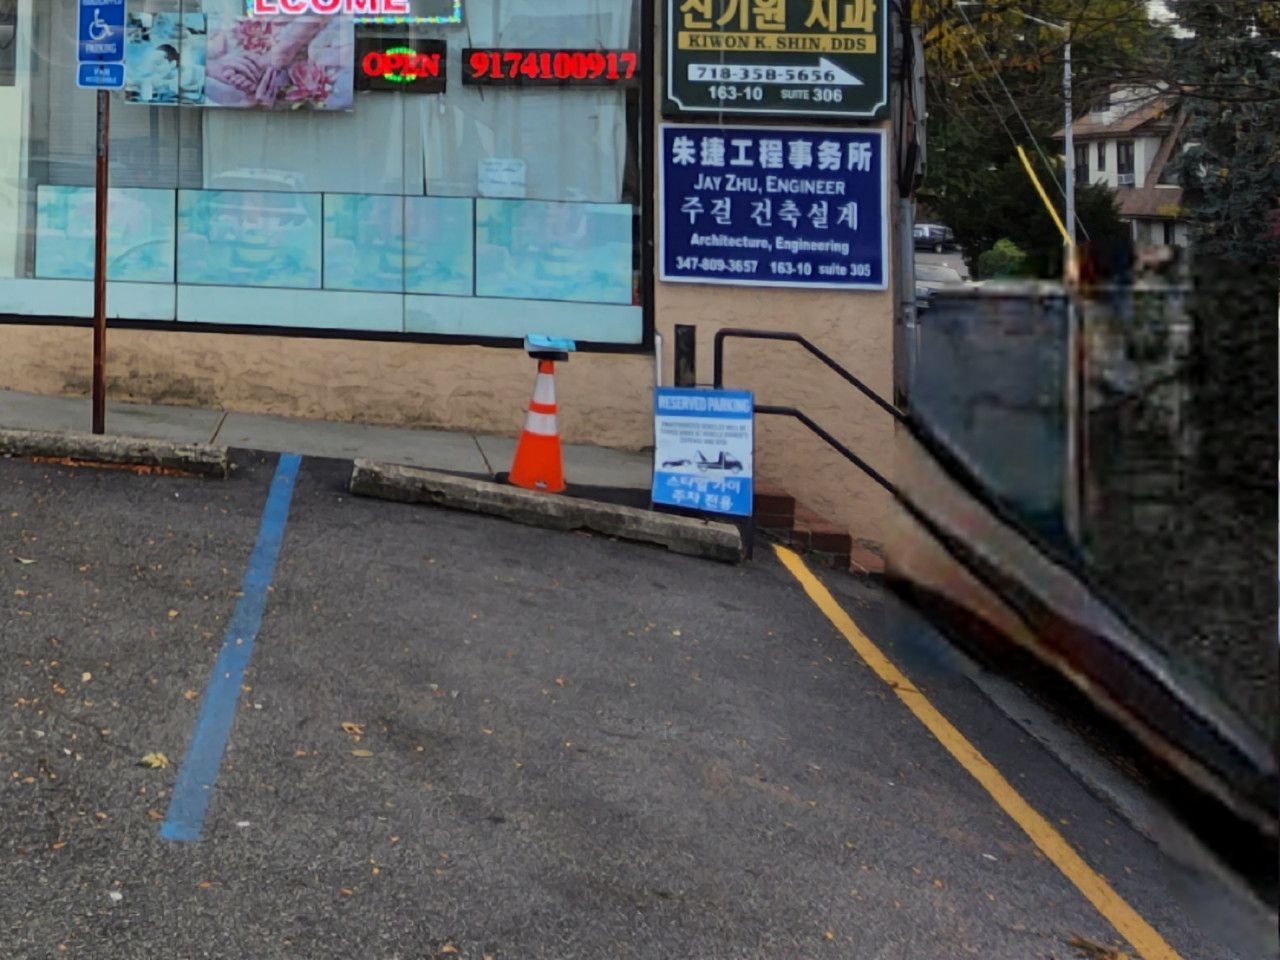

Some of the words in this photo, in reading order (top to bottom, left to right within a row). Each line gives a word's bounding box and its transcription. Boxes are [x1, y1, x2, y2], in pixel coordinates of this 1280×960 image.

[688, 34, 752, 49] KIWON
[831, 38, 867, 51] DDS
[362, 50, 440, 79] OPEN
[470, 52, 637, 79] 9174100917
[696, 67, 835, 82] 718-358-5656
[708, 86, 763, 100] 163-10
[781, 89, 809, 100] SUITE
[813, 89, 843, 102] 306
[694, 173, 723, 190] JAY
[766, 176, 845, 195] ENGINEER
[750, 198, 858, 231] 건축설계
[775, 236, 849, 256] Engineering
[770, 262, 812, 275] 163-10
[818, 264, 847, 276] suite
[850, 264, 871, 277] 305
